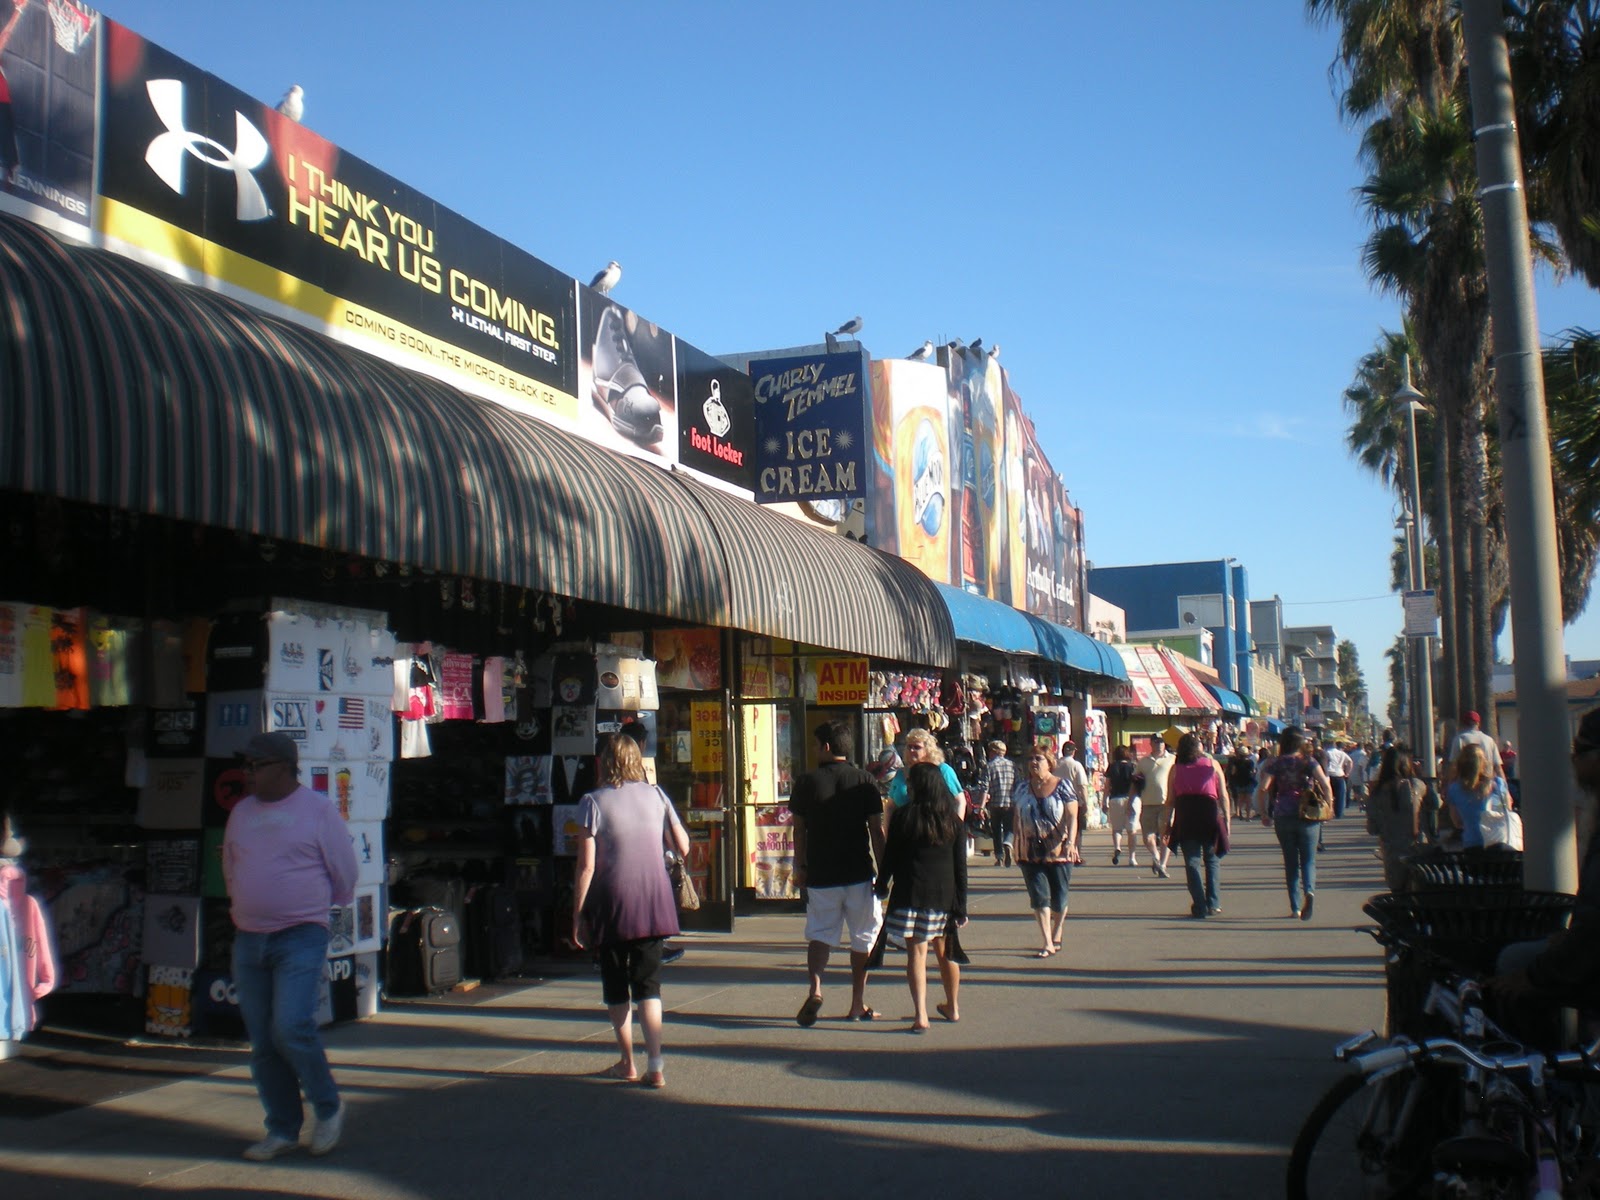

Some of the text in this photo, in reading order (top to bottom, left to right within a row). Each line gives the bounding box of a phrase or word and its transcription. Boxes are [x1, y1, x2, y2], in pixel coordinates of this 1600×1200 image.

[8, 171, 87, 216] JENNINGS
[288, 153, 434, 253] I THINK YOU
[288, 185, 560, 350] HEAR US COMING.
[465, 312, 504, 342] LETHAL
[504, 331, 532, 352] FIRST
[345, 310, 396, 341] COMING
[464, 360, 496, 382] MICRO
[508, 378, 538, 399] BLACK
[754, 362, 825, 404] CHARLY
[782, 372, 857, 422] TEMMEL
[690, 427, 743, 467] Foot Locker
[785, 428, 832, 461] ICE
[760, 461, 857, 495] CREAM
[819, 661, 867, 686] ATM
[273, 702, 307, 728] SEX
[820, 689, 867, 702] INSIDE
